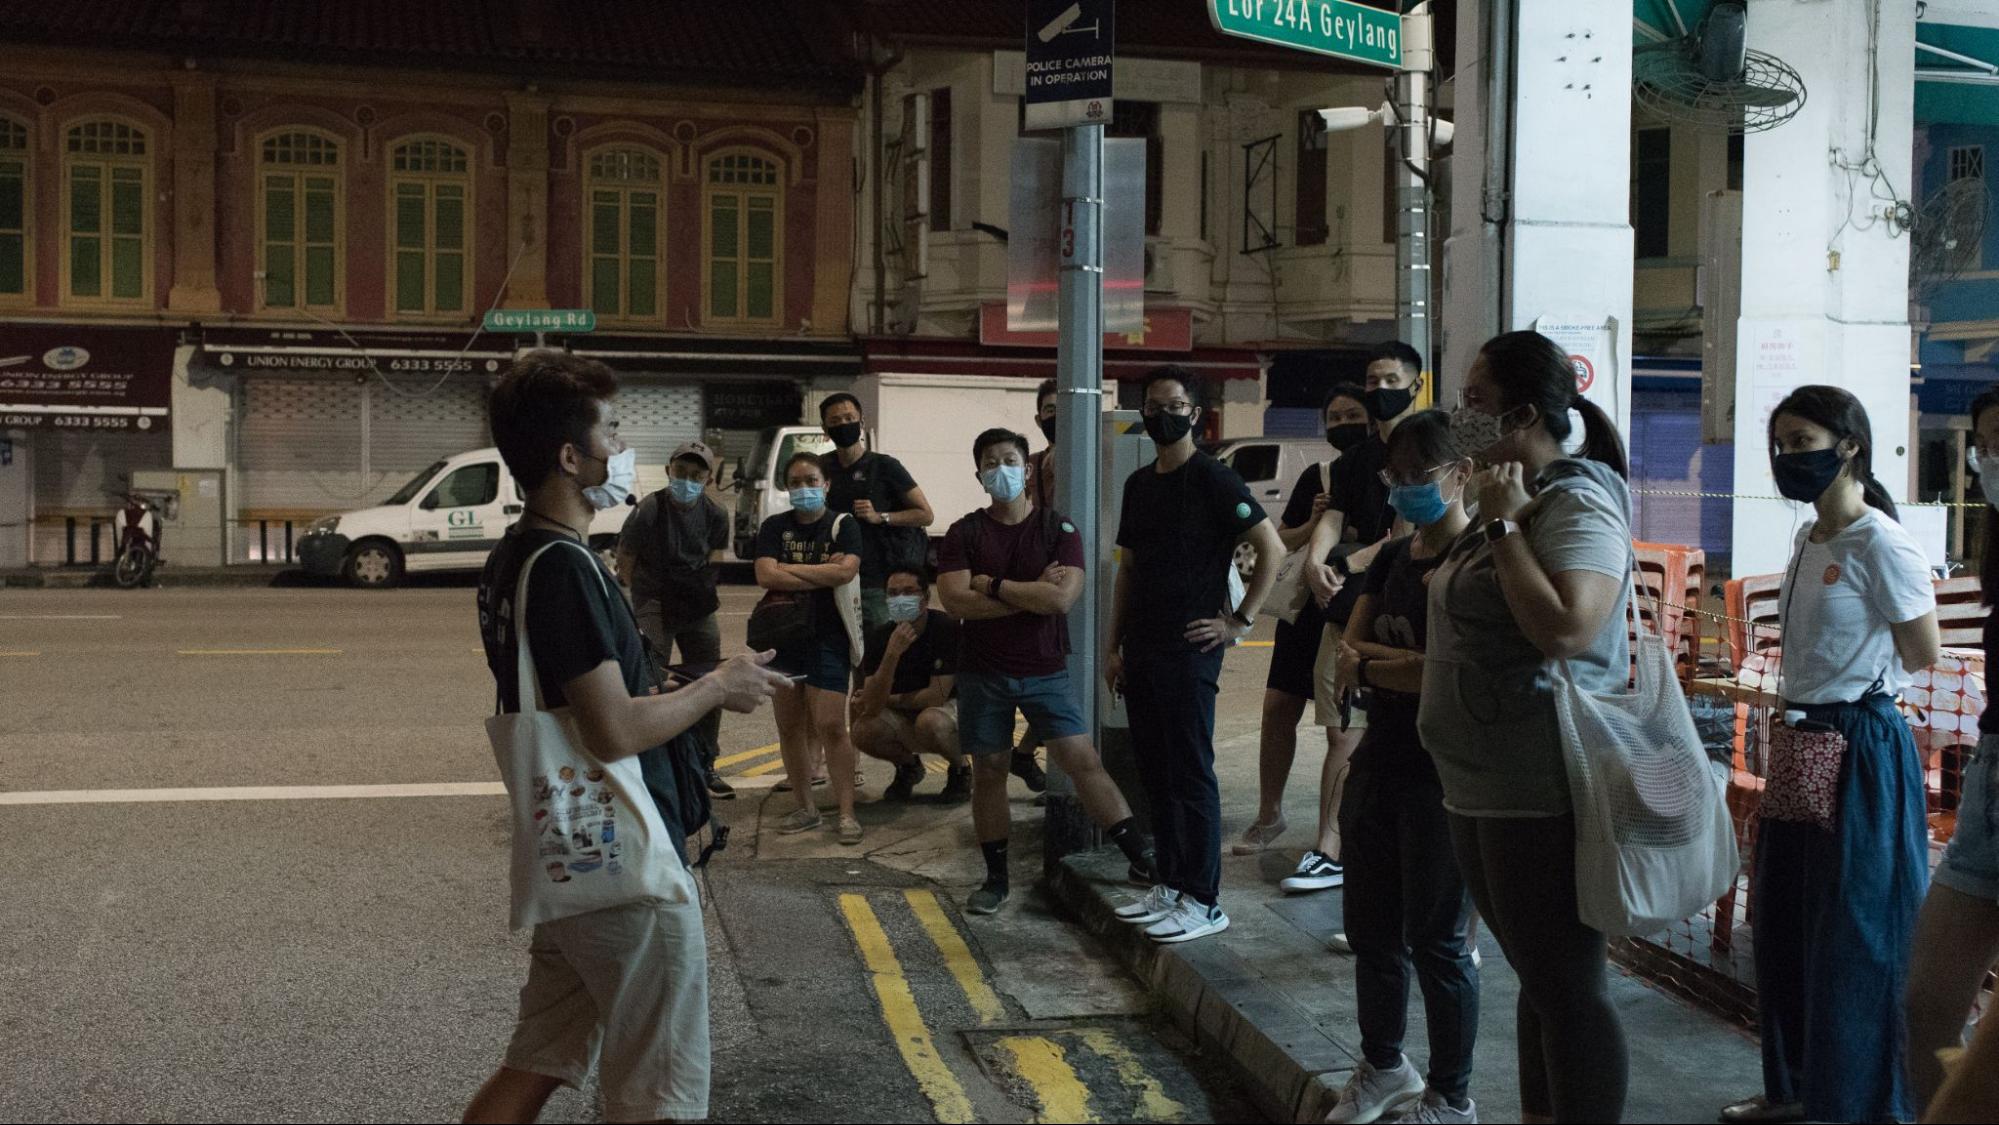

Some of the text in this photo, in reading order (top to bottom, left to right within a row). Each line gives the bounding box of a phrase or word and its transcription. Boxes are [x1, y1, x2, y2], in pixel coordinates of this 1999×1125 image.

[1273, 0, 1313, 33] 24A
[1320, 3, 1397, 60] Geylang
[1027, 55, 1112, 73] POLICE CAMERA
[1030, 70, 1108, 86] IN OPERATION
[493, 312, 587, 329] Geylang Rd
[247, 354, 472, 371] UNION ENERGY GROUP 6333 5555
[0, 380, 128, 390] 6333 5555
[4, 415, 128, 427] GROUP 6333 5555
[448, 511, 484, 526] GL
